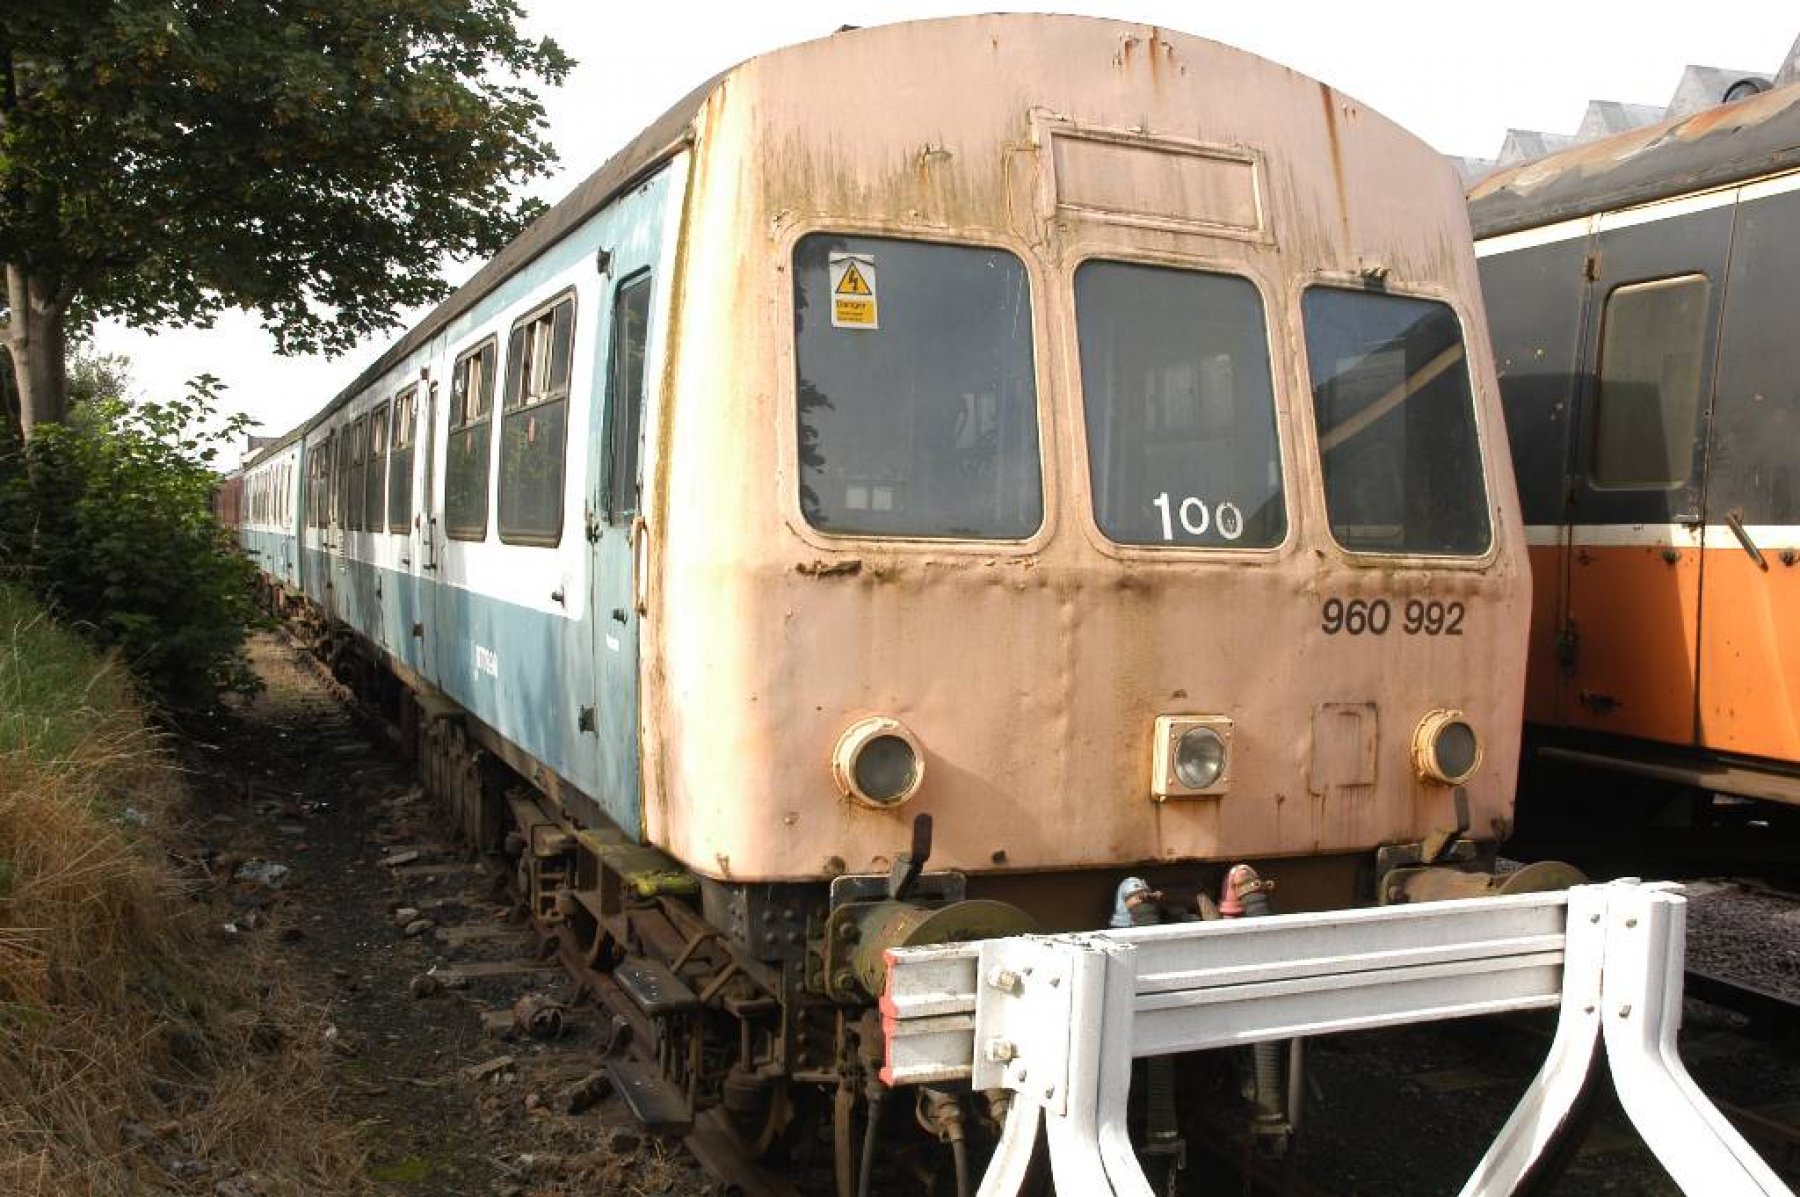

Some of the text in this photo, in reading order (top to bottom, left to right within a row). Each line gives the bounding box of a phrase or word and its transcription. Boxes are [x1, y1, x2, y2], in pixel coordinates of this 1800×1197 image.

[1153, 492, 1244, 540] 100
[1321, 598, 1465, 635] 960 992
